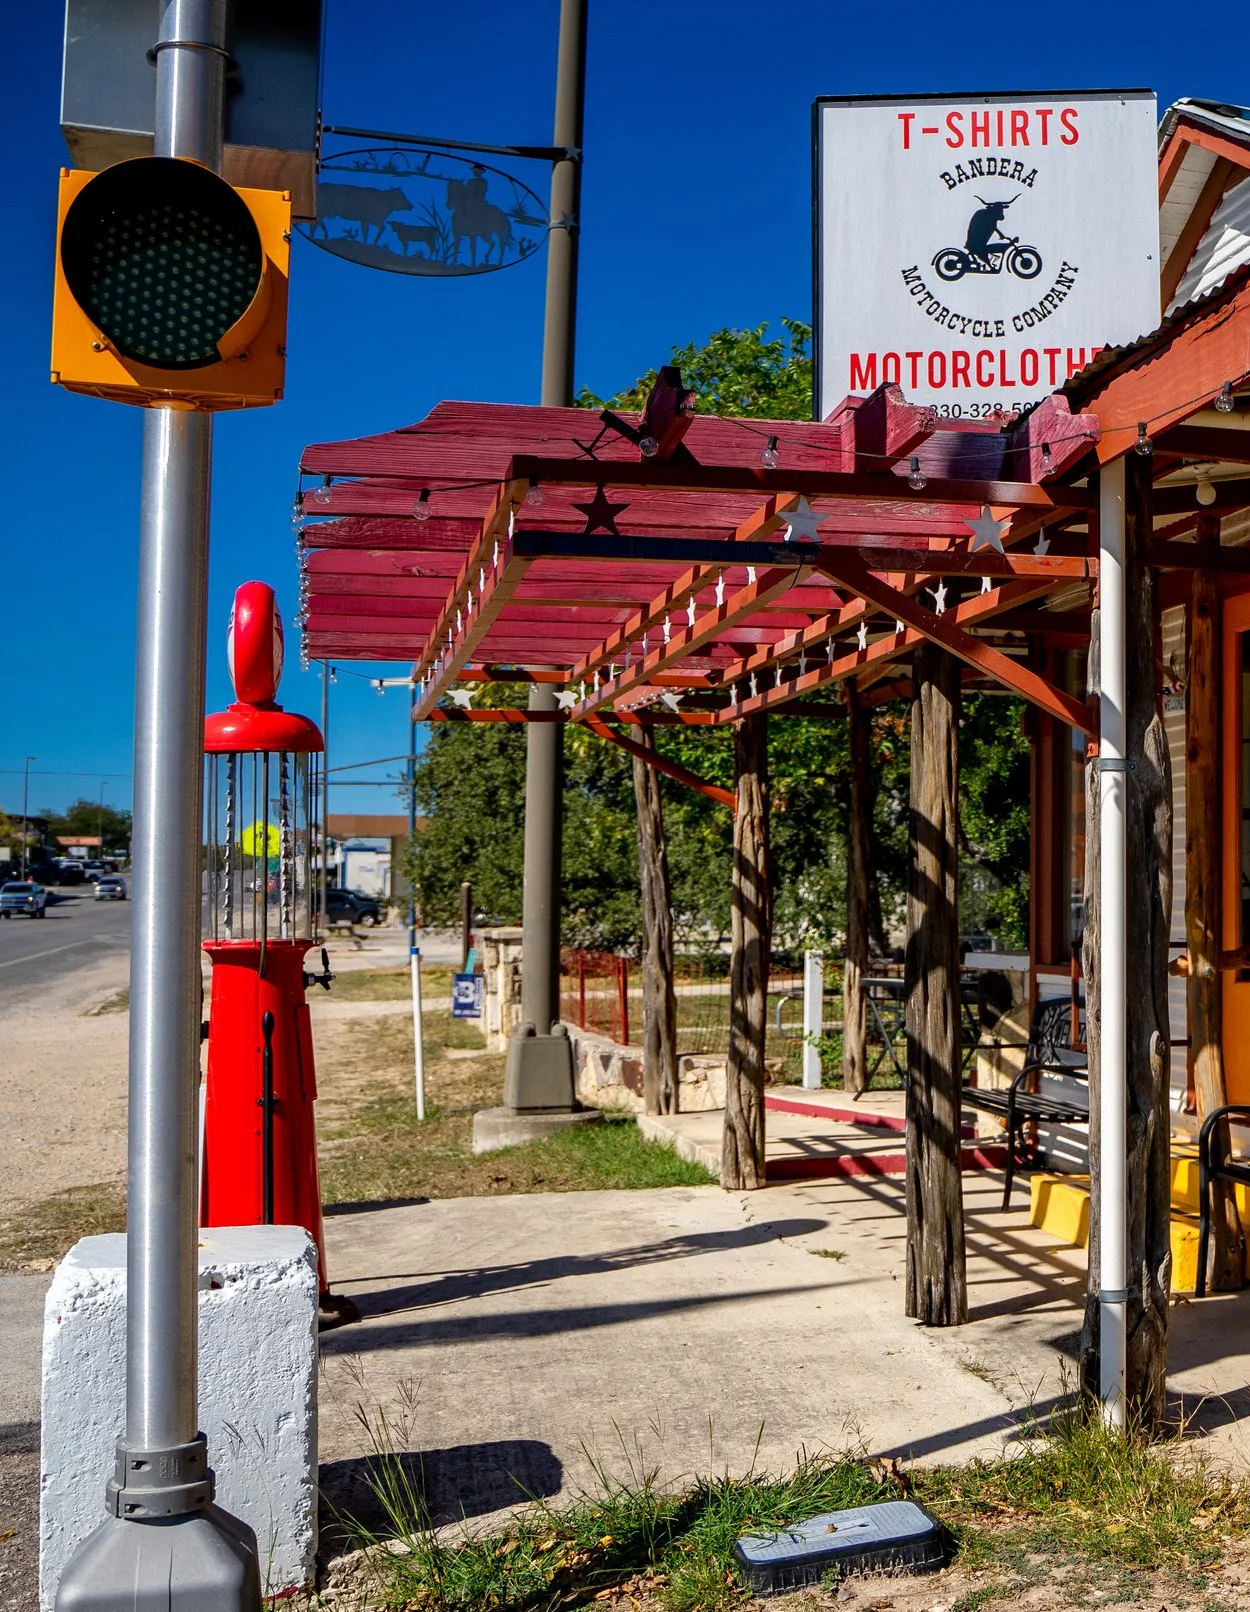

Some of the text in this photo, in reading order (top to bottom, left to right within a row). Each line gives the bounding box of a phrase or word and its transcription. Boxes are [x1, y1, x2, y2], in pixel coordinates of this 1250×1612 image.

[897, 108, 1080, 150] T-SHIRTS
[939, 157, 1039, 191] BANDERA
[901, 260, 1079, 338] MOTORCYCLE COMPANY
[850, 347, 1104, 391] MOTORCLOTH
